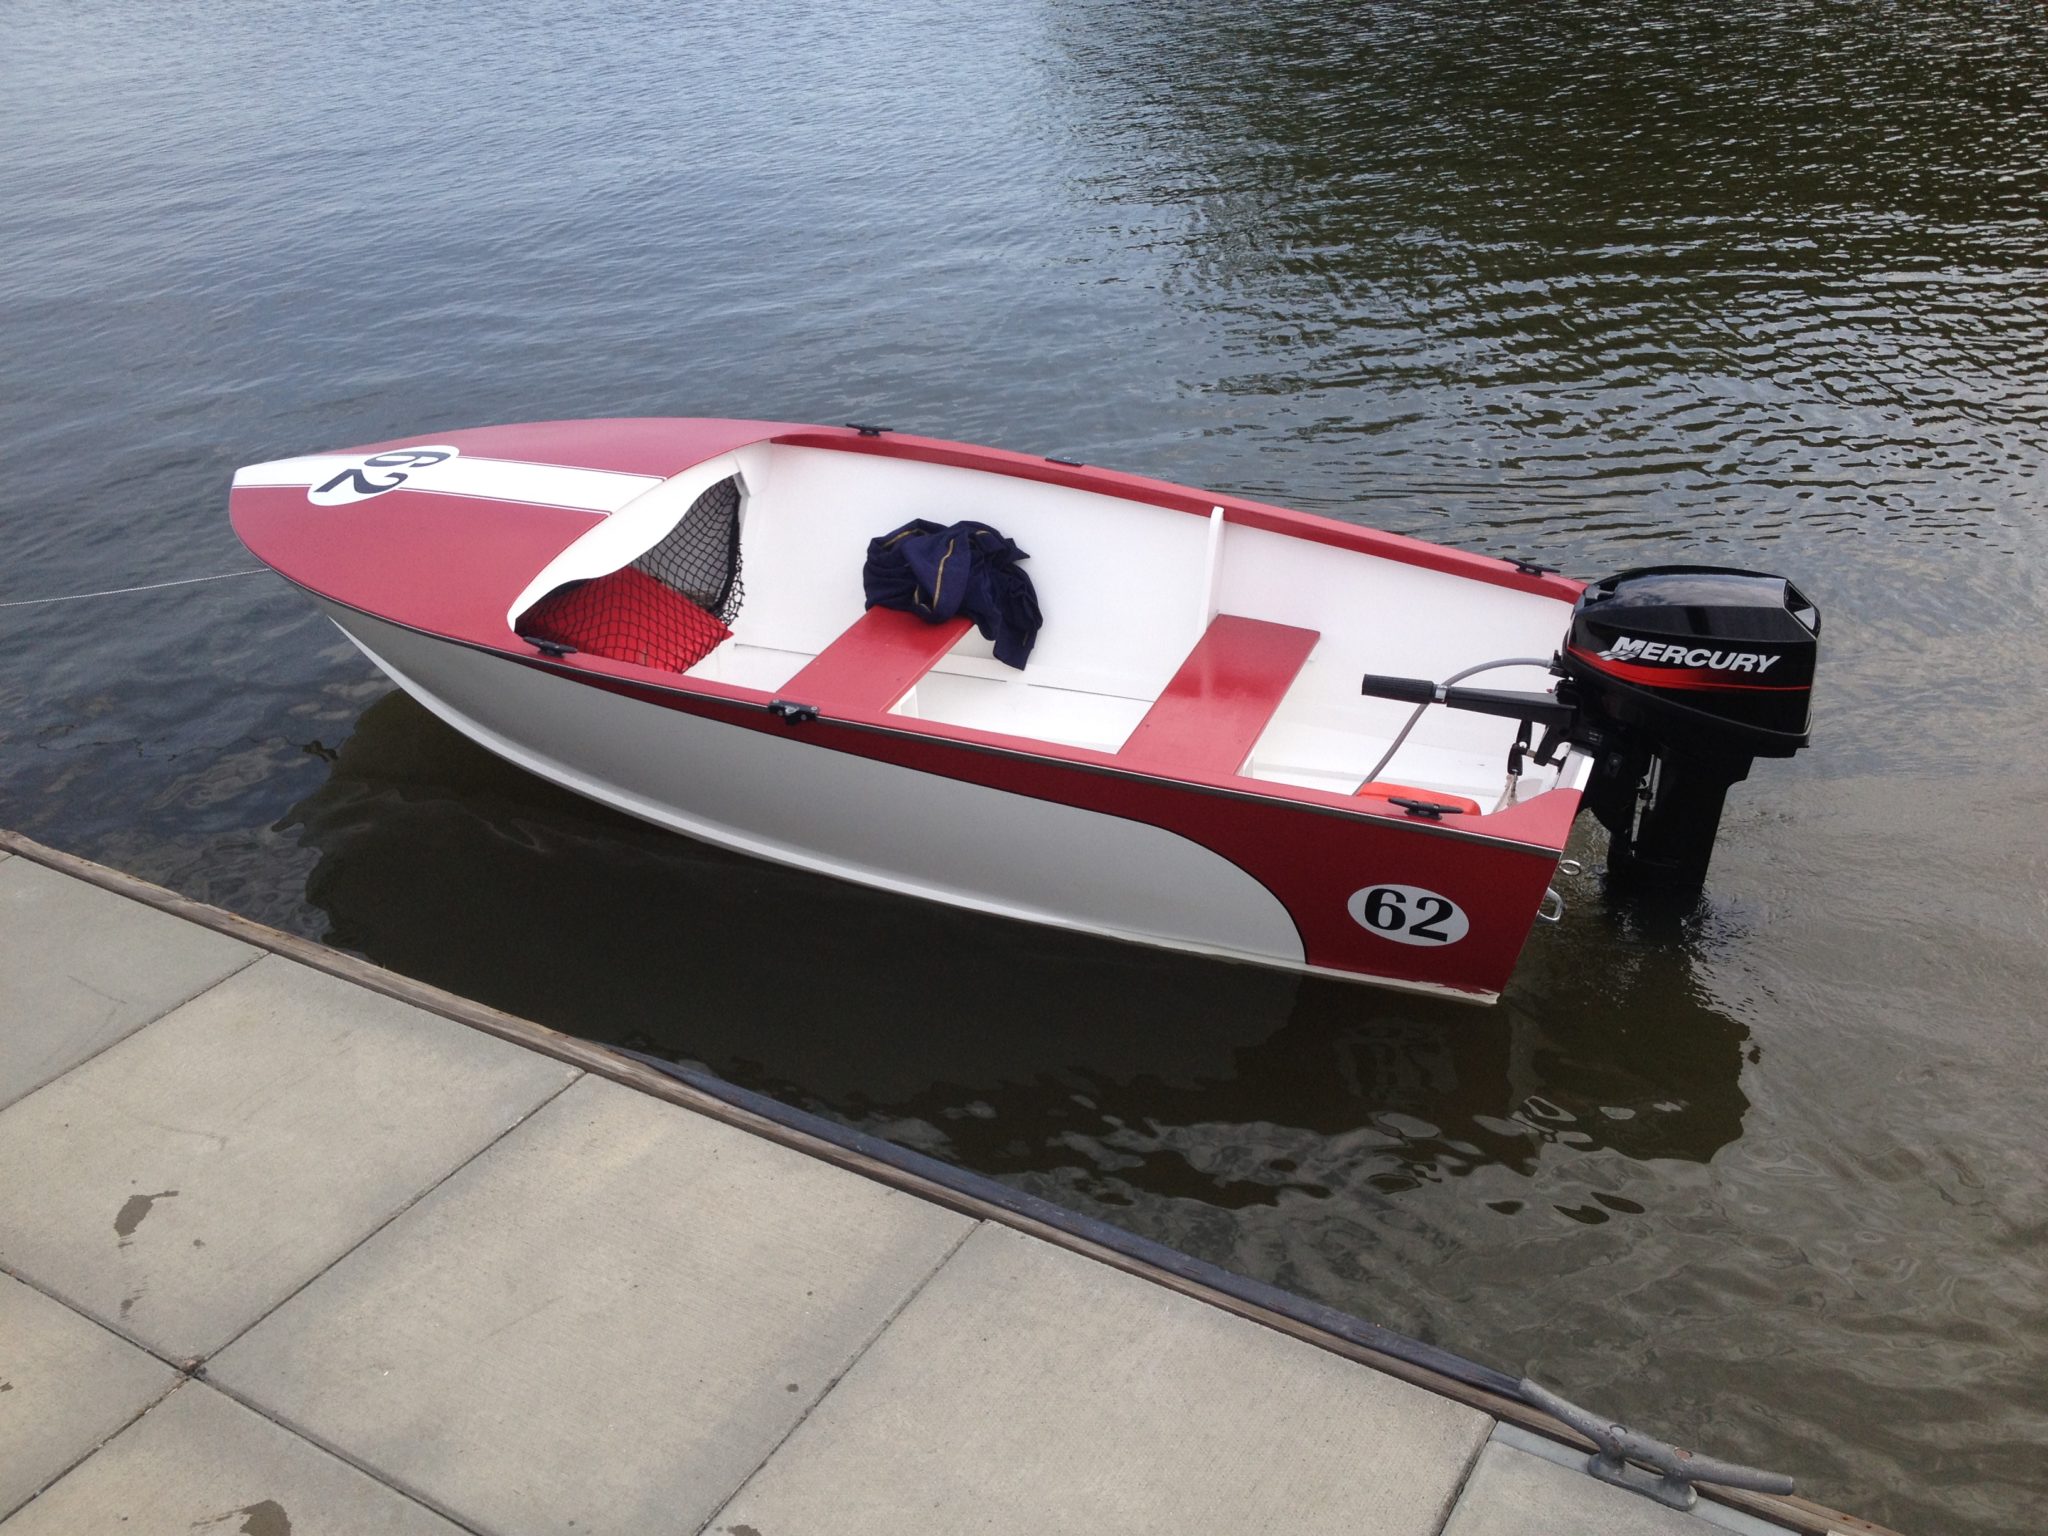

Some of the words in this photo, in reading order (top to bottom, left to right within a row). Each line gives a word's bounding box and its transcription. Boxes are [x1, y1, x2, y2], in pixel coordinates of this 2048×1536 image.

[313, 450, 451, 494] 62
[1600, 636, 1781, 673] MERCURY
[1364, 887, 1453, 942] 62
